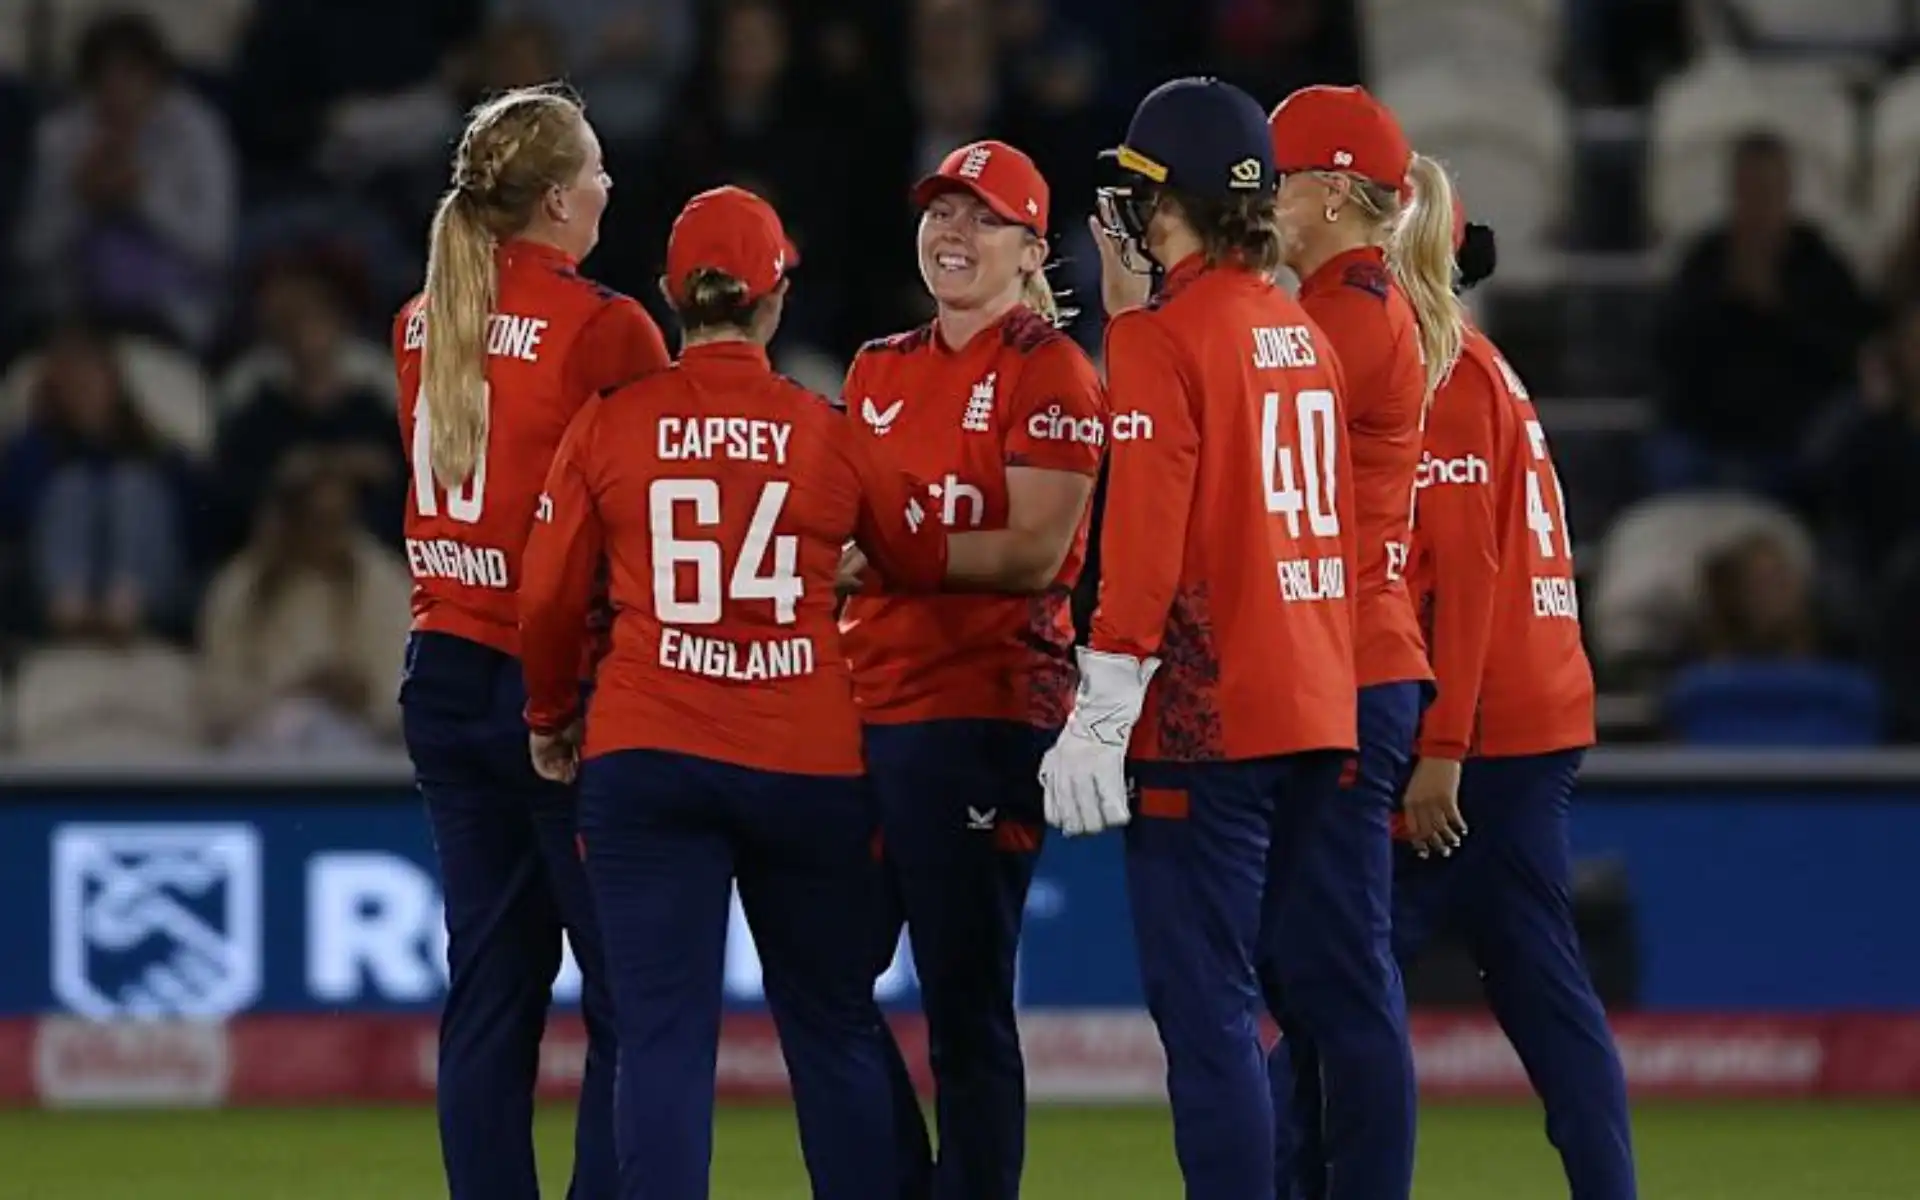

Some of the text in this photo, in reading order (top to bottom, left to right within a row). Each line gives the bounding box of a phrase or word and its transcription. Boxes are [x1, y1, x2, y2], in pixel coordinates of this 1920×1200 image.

[1251, 325, 1316, 368] JONES
[657, 417, 791, 464] CAPSEY
[1027, 404, 1104, 446] cinch
[1261, 389, 1340, 539] 40
[649, 478, 804, 625] 64
[659, 628, 813, 680] ENGLAND
